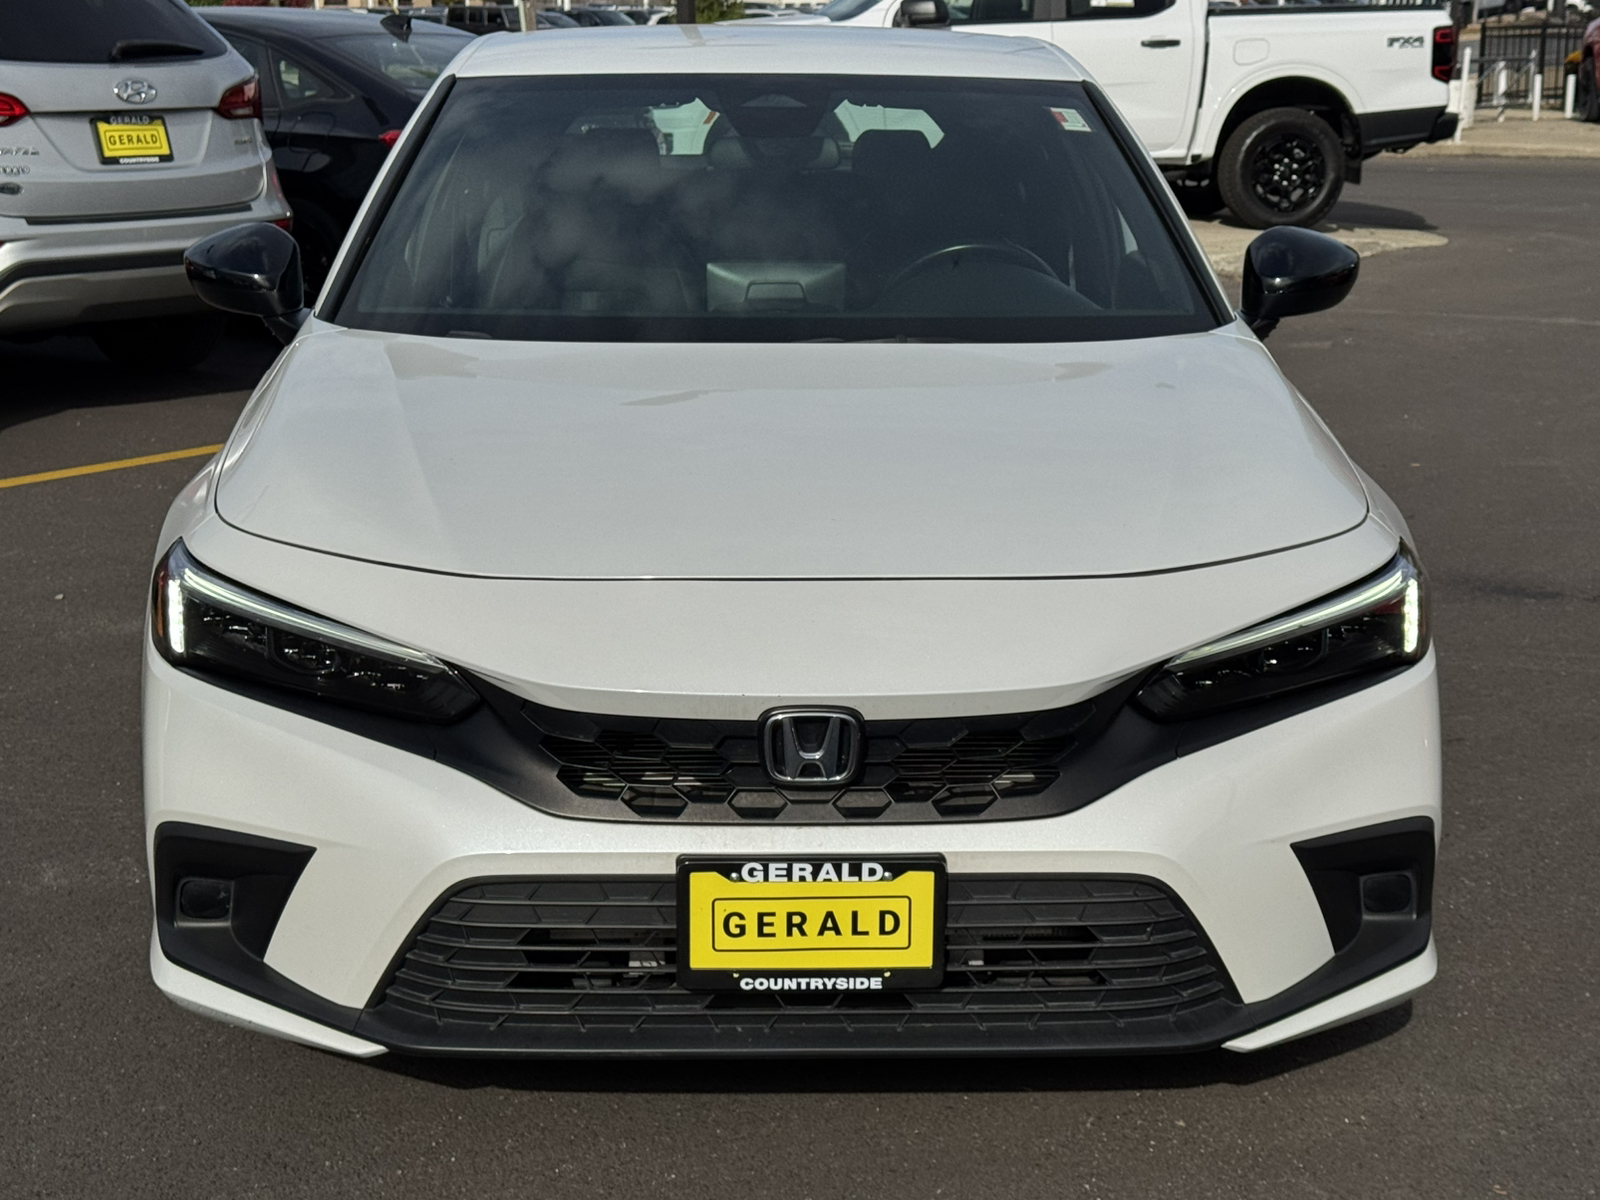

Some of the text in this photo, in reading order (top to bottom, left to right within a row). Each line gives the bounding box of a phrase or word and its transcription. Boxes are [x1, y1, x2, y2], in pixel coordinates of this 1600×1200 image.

[1387, 36, 1424, 49] FX4
[110, 115, 150, 126] GERALD
[108, 133, 158, 146] GERALD
[740, 862, 884, 883] GERALD
[722, 910, 901, 938] GERALD
[739, 977, 883, 991] COUNTRYSIDE
